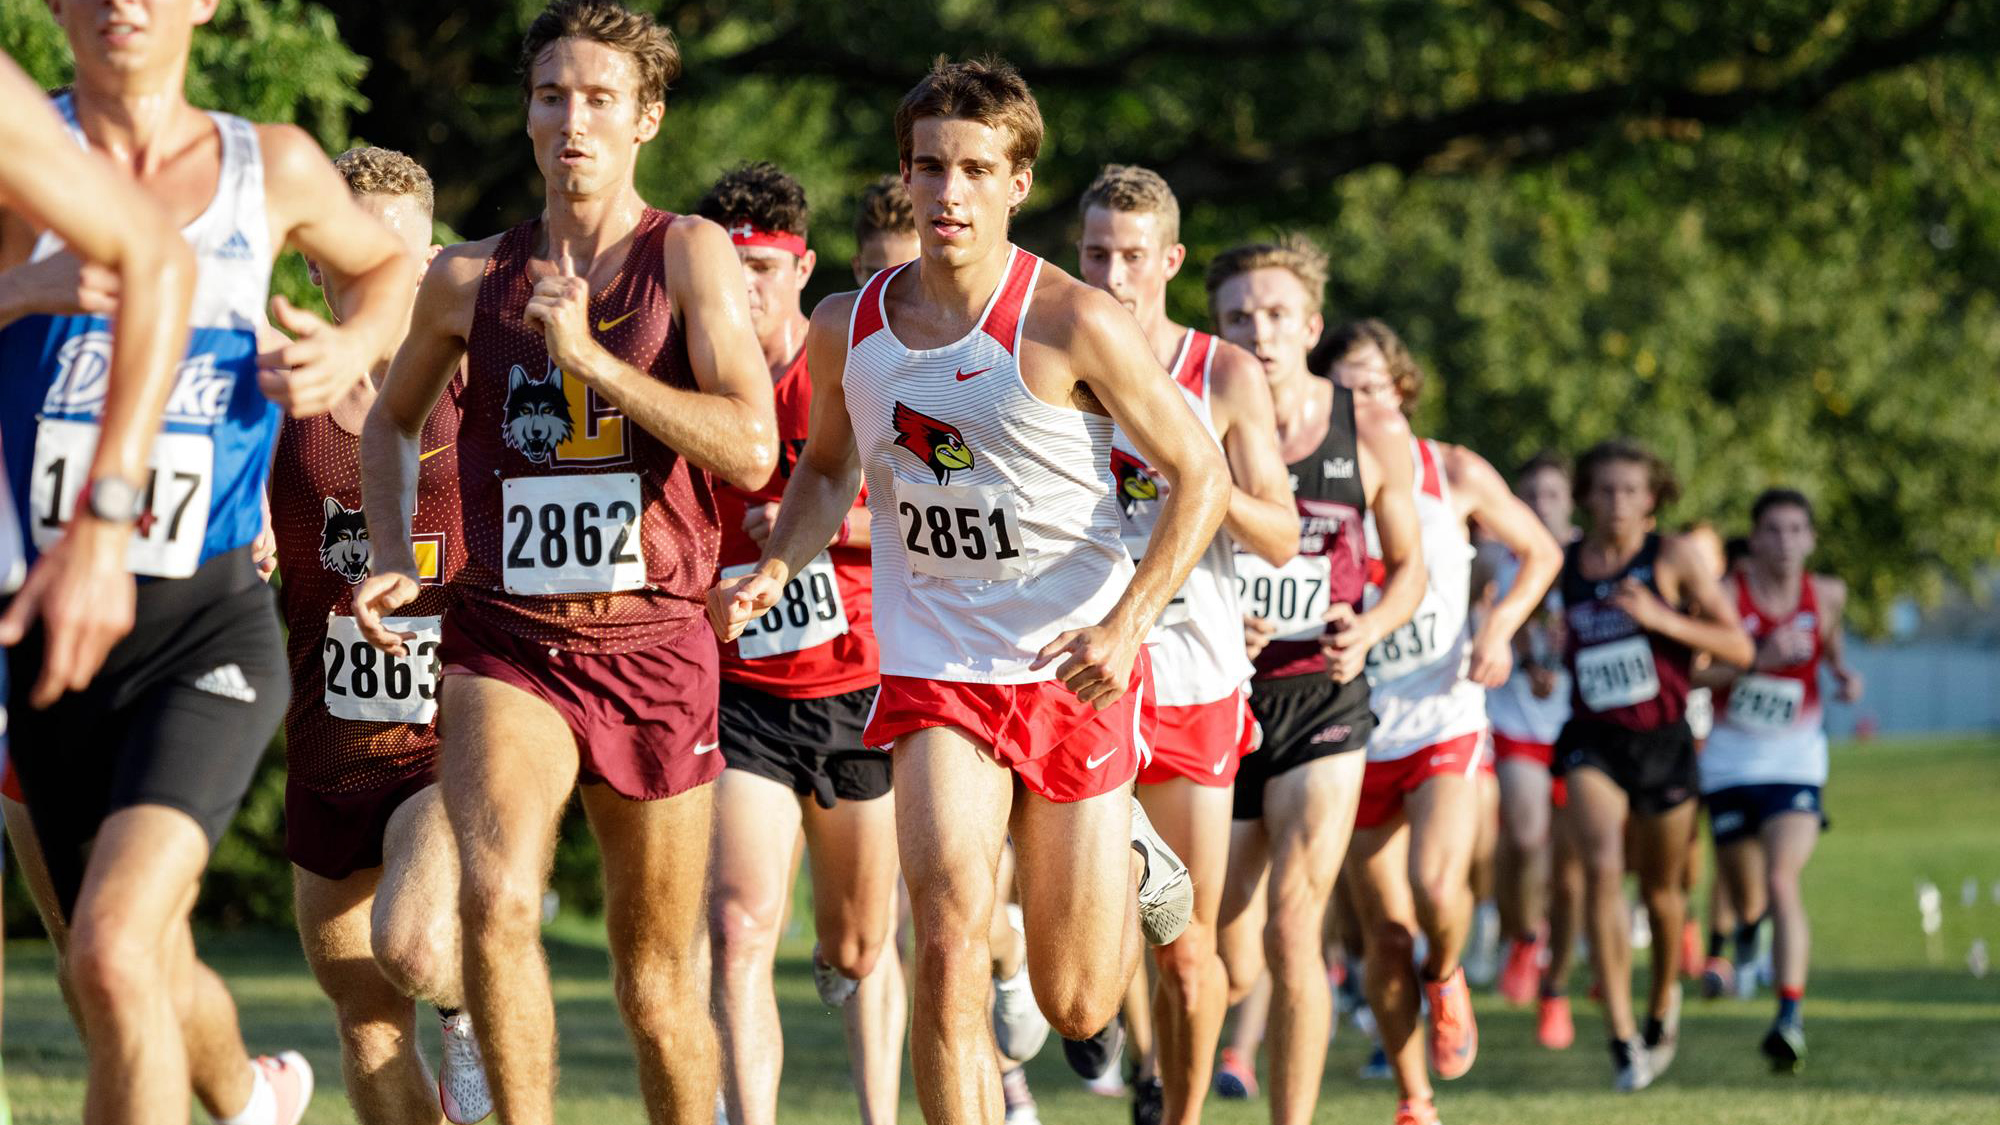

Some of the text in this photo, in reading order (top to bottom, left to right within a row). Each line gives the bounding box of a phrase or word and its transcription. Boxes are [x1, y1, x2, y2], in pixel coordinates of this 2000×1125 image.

[43, 331, 236, 424] Dke
[506, 500, 639, 569] 2862
[900, 501, 1020, 561] 2851
[325, 637, 441, 700] 2863
